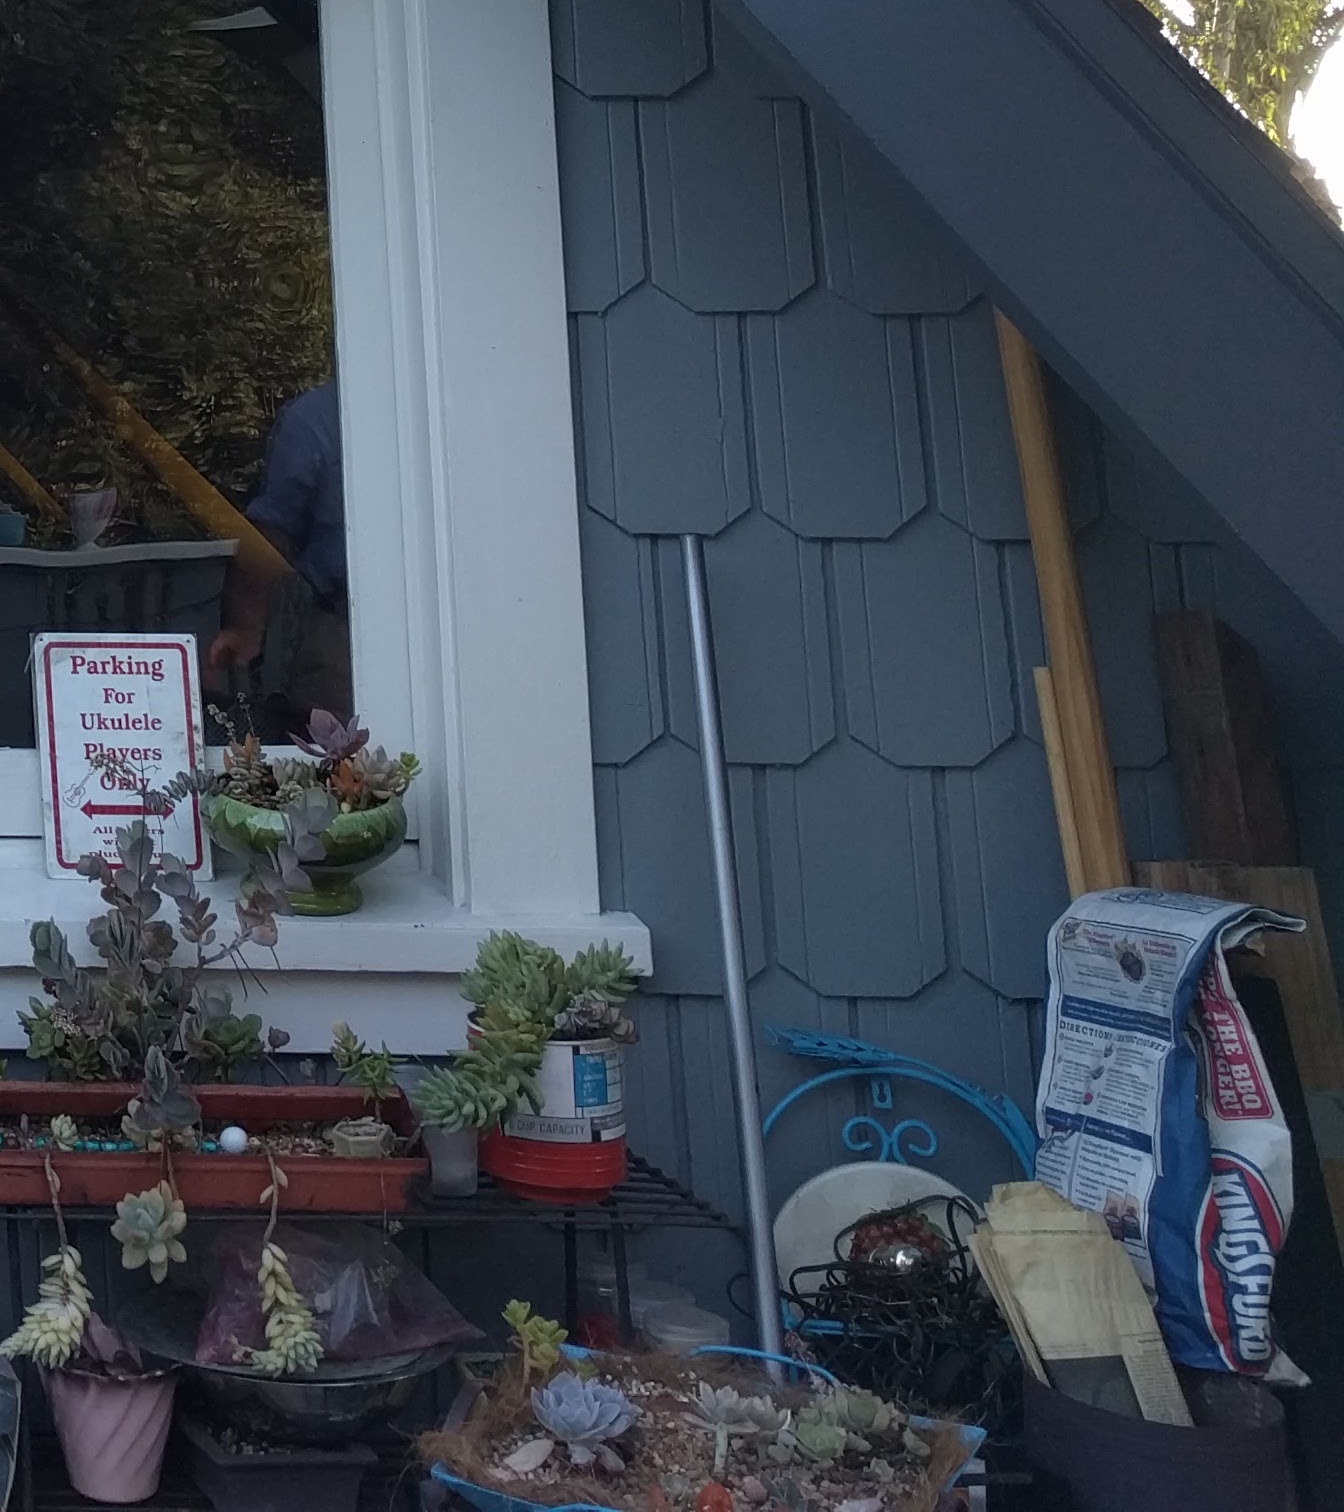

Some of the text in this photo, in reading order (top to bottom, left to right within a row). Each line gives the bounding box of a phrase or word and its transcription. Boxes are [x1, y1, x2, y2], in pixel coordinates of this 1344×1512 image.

[70, 655, 165, 682] Parking
[102, 687, 136, 704] For
[80, 713, 163, 731] Ukulele
[84, 742, 163, 764] Players
[92, 826, 113, 834] All
[1213, 1010, 1262, 1110] THE BBQ
[540, 1122, 586, 1136] CAPACITY
[1212, 1172, 1276, 1362] KINGSFORD
